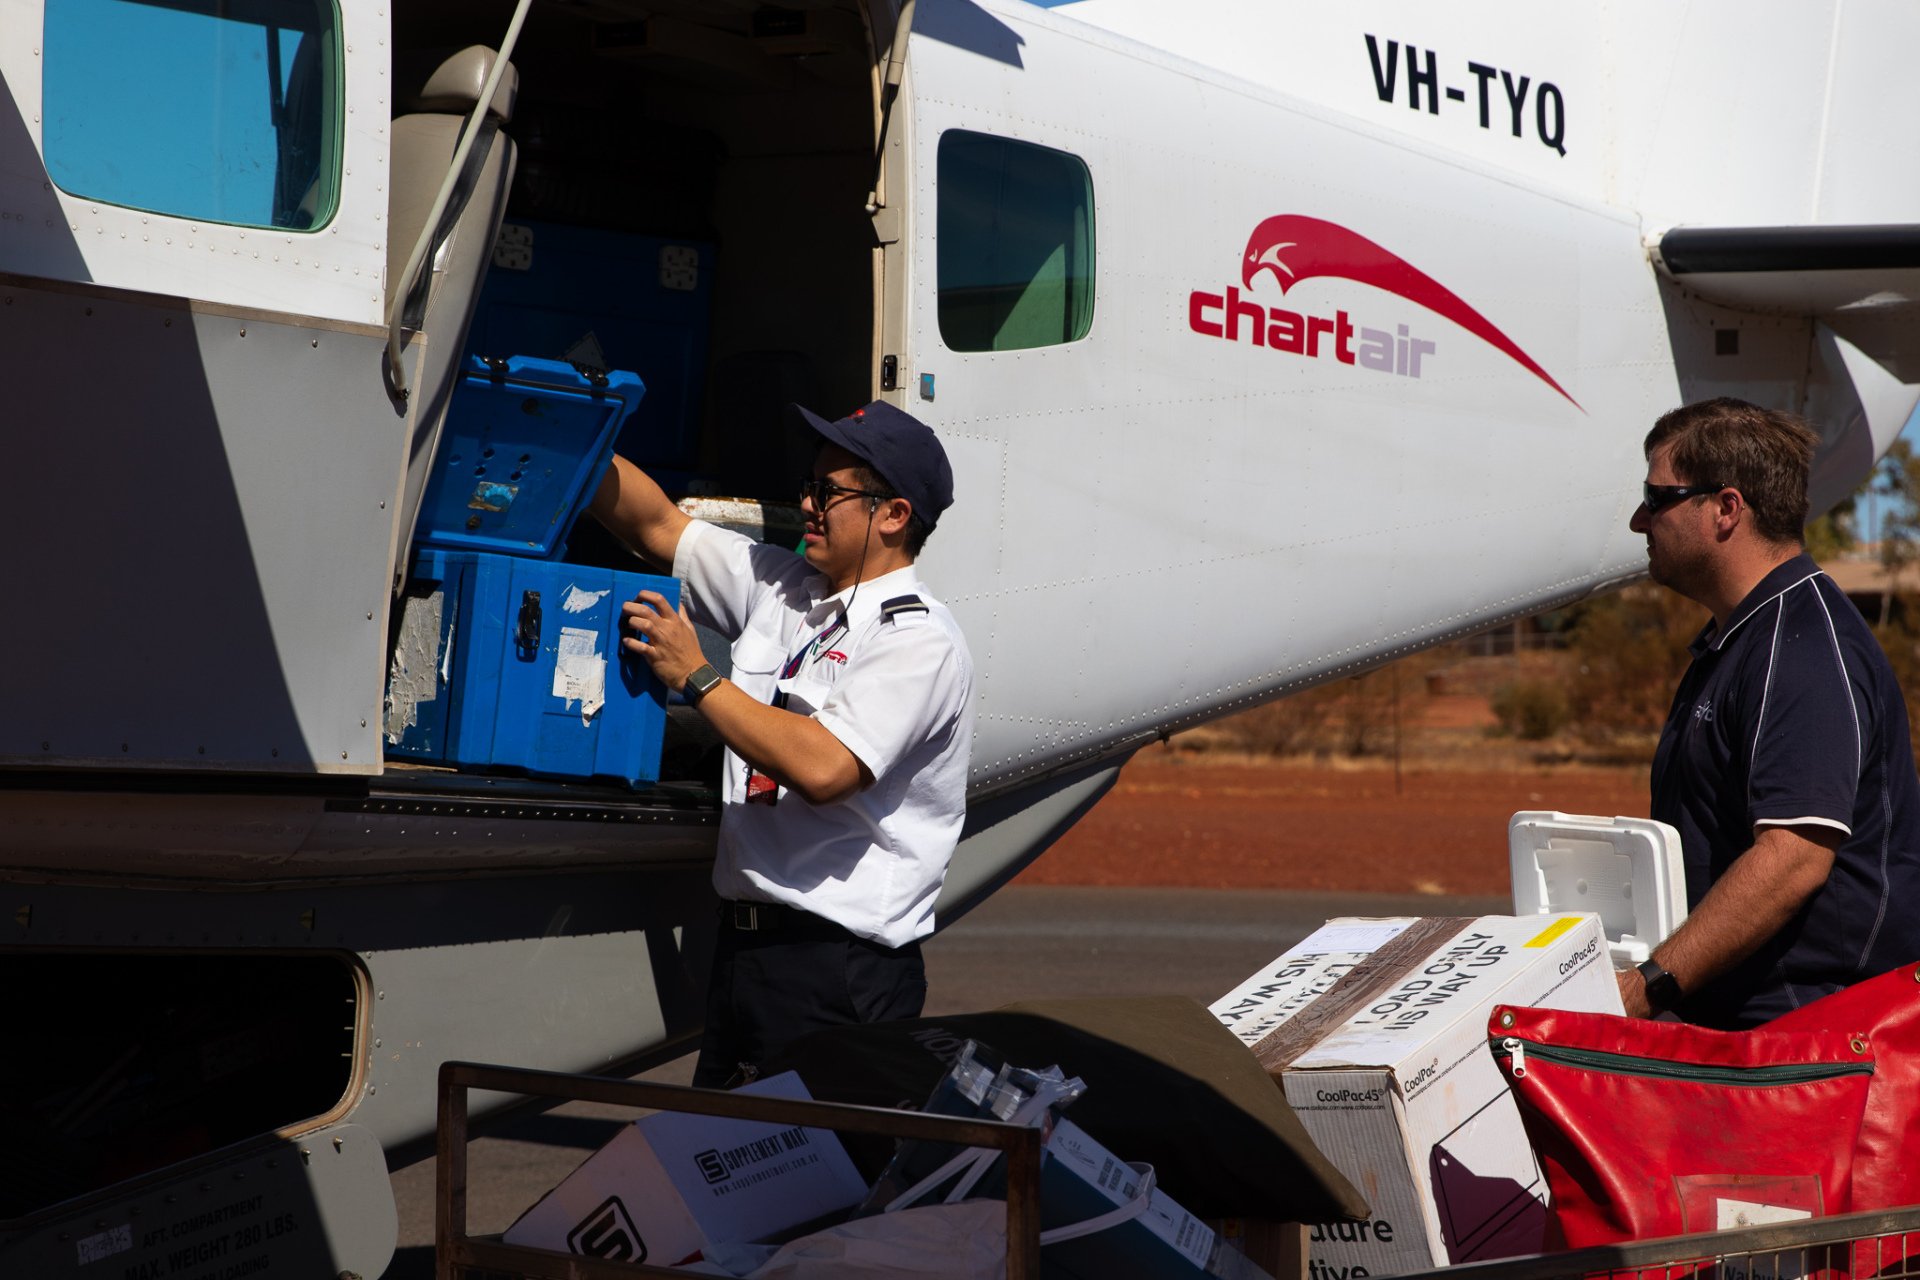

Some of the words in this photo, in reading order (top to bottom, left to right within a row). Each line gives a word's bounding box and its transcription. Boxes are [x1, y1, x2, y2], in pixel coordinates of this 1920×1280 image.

[1364, 33, 1567, 158] VH-TYQ
[1189, 285, 1436, 378] chartair
[1413, 972, 1478, 1007] WAY
[1467, 945, 1509, 967] UP
[723, 1135, 783, 1170] SUPPLEMENT
[779, 1126, 809, 1150] MART
[142, 1227, 169, 1249] AFT.
[172, 1195, 264, 1239] COMPARTMENT
[168, 1235, 230, 1273] WEIGHT
[235, 1224, 261, 1251] 280
[265, 1213, 299, 1240] LBS.
